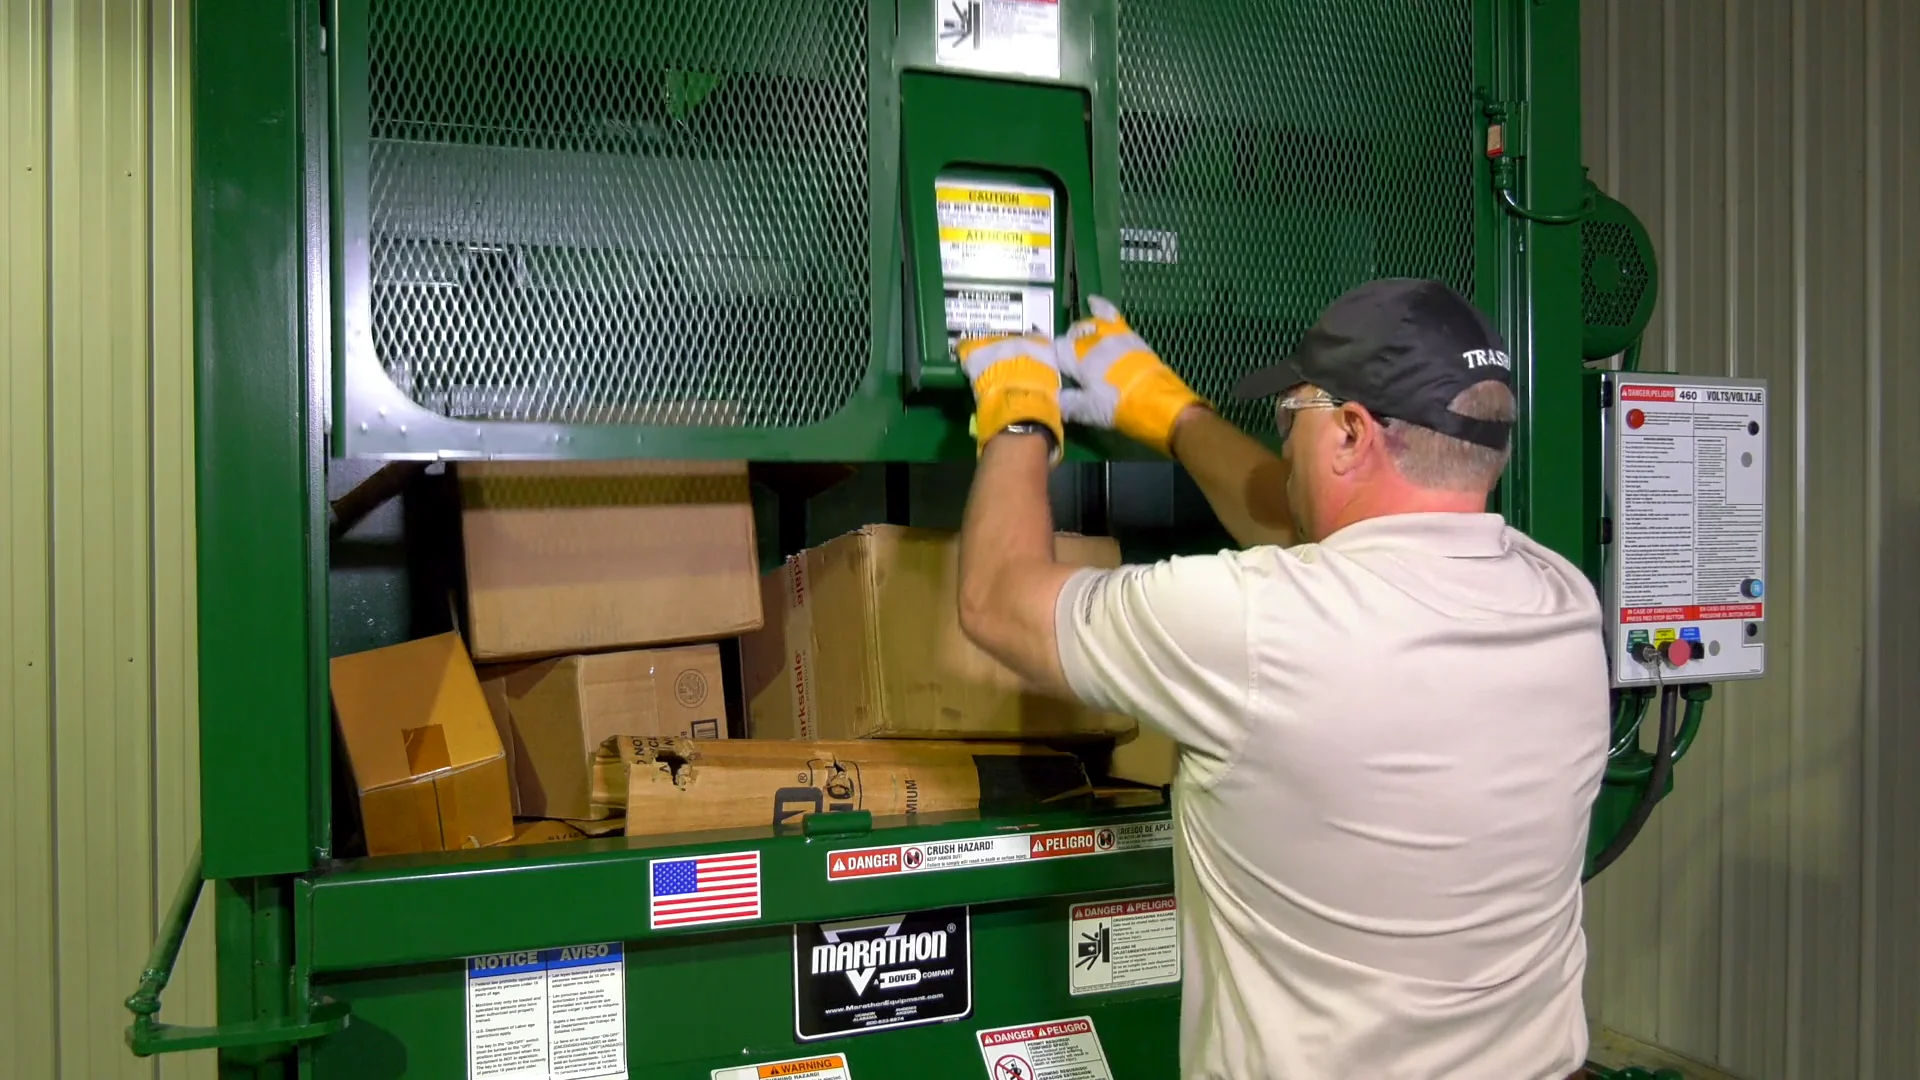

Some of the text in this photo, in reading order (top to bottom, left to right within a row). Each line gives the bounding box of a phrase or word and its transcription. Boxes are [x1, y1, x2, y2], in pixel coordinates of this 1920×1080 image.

[969, 191, 1019, 205] CAUTION
[1680, 391, 1697, 400] 460
[1707, 391, 1762, 402] VOLTS/VOLTAJE
[927, 841, 993, 855] CRUSH HAZARD!
[1046, 835, 1092, 851] PELIGRO
[848, 854, 898, 870] DANGER
[1085, 899, 1174, 917] DANGER PELIGRO
[475, 944, 608, 970] NOTICE AVISO
[812, 930, 947, 974] MARATHON
[888, 973, 916, 983] DOVER
[923, 969, 954, 978] COMPANY
[825, 993, 943, 1014] www.MarathonEquipment.com
[994, 1022, 1088, 1043] DANGER PELIGRO
[781, 1059, 832, 1073] WARNING
